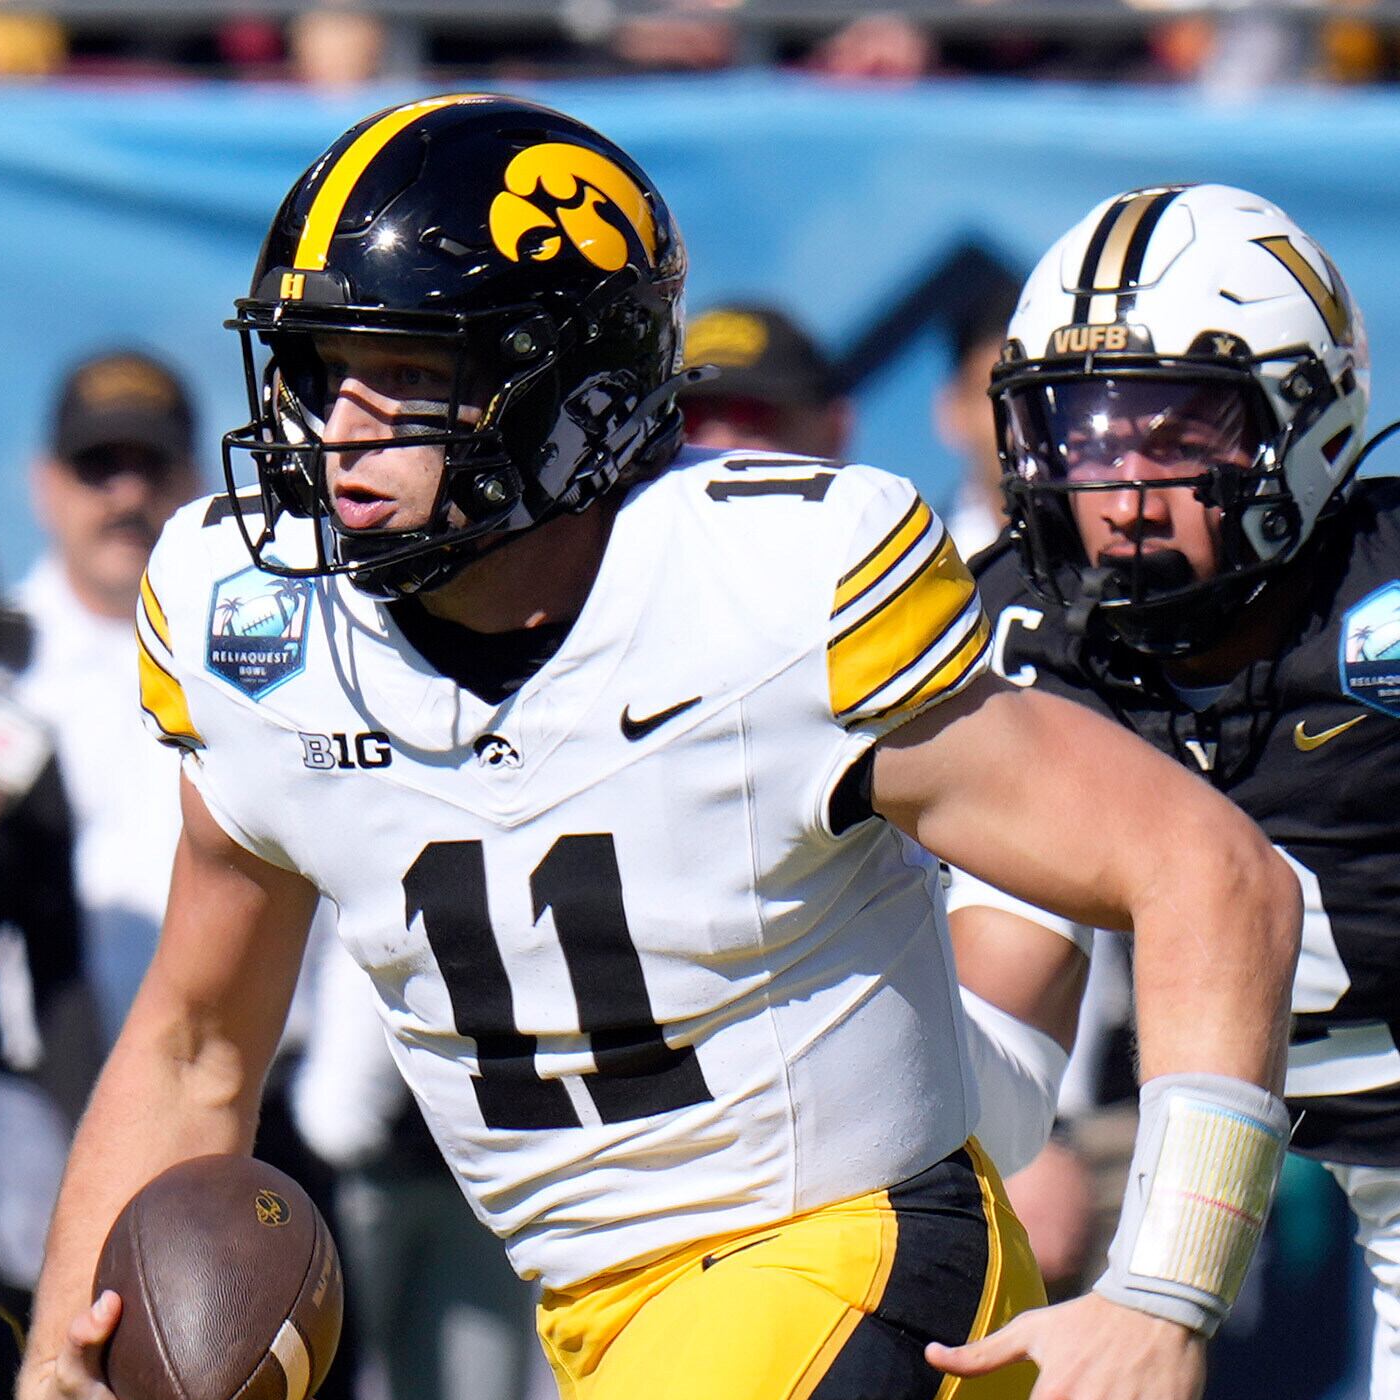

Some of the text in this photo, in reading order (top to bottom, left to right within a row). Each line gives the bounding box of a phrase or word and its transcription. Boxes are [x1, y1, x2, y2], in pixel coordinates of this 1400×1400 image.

[1054, 325, 1128, 353] VUFB
[212, 650, 289, 664] RELIAQUEST
[239, 666, 267, 677] BOWL
[401, 832, 715, 1130] 11
